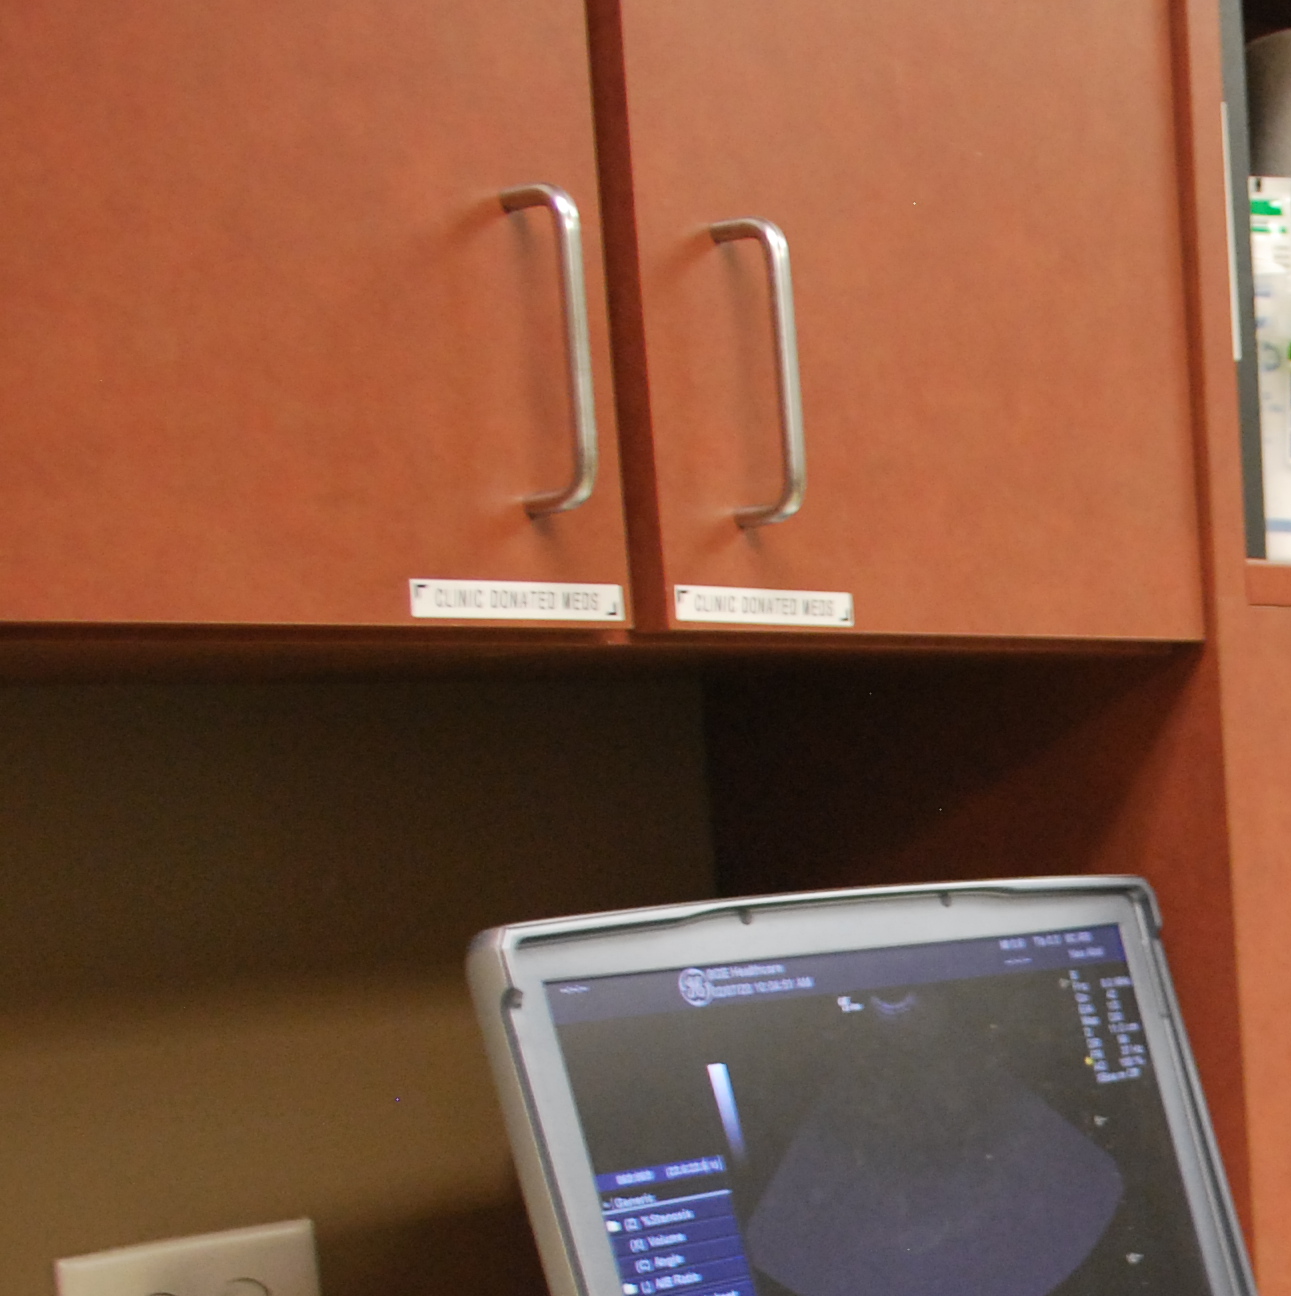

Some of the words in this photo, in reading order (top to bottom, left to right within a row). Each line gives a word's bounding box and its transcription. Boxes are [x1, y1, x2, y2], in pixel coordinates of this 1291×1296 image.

[435, 588, 482, 609] CLINIC
[490, 590, 556, 611] DONATED
[560, 592, 600, 612] MEDS
[694, 594, 737, 614] CLINIC
[741, 596, 797, 617] DONATED
[802, 598, 834, 618] MEDS
